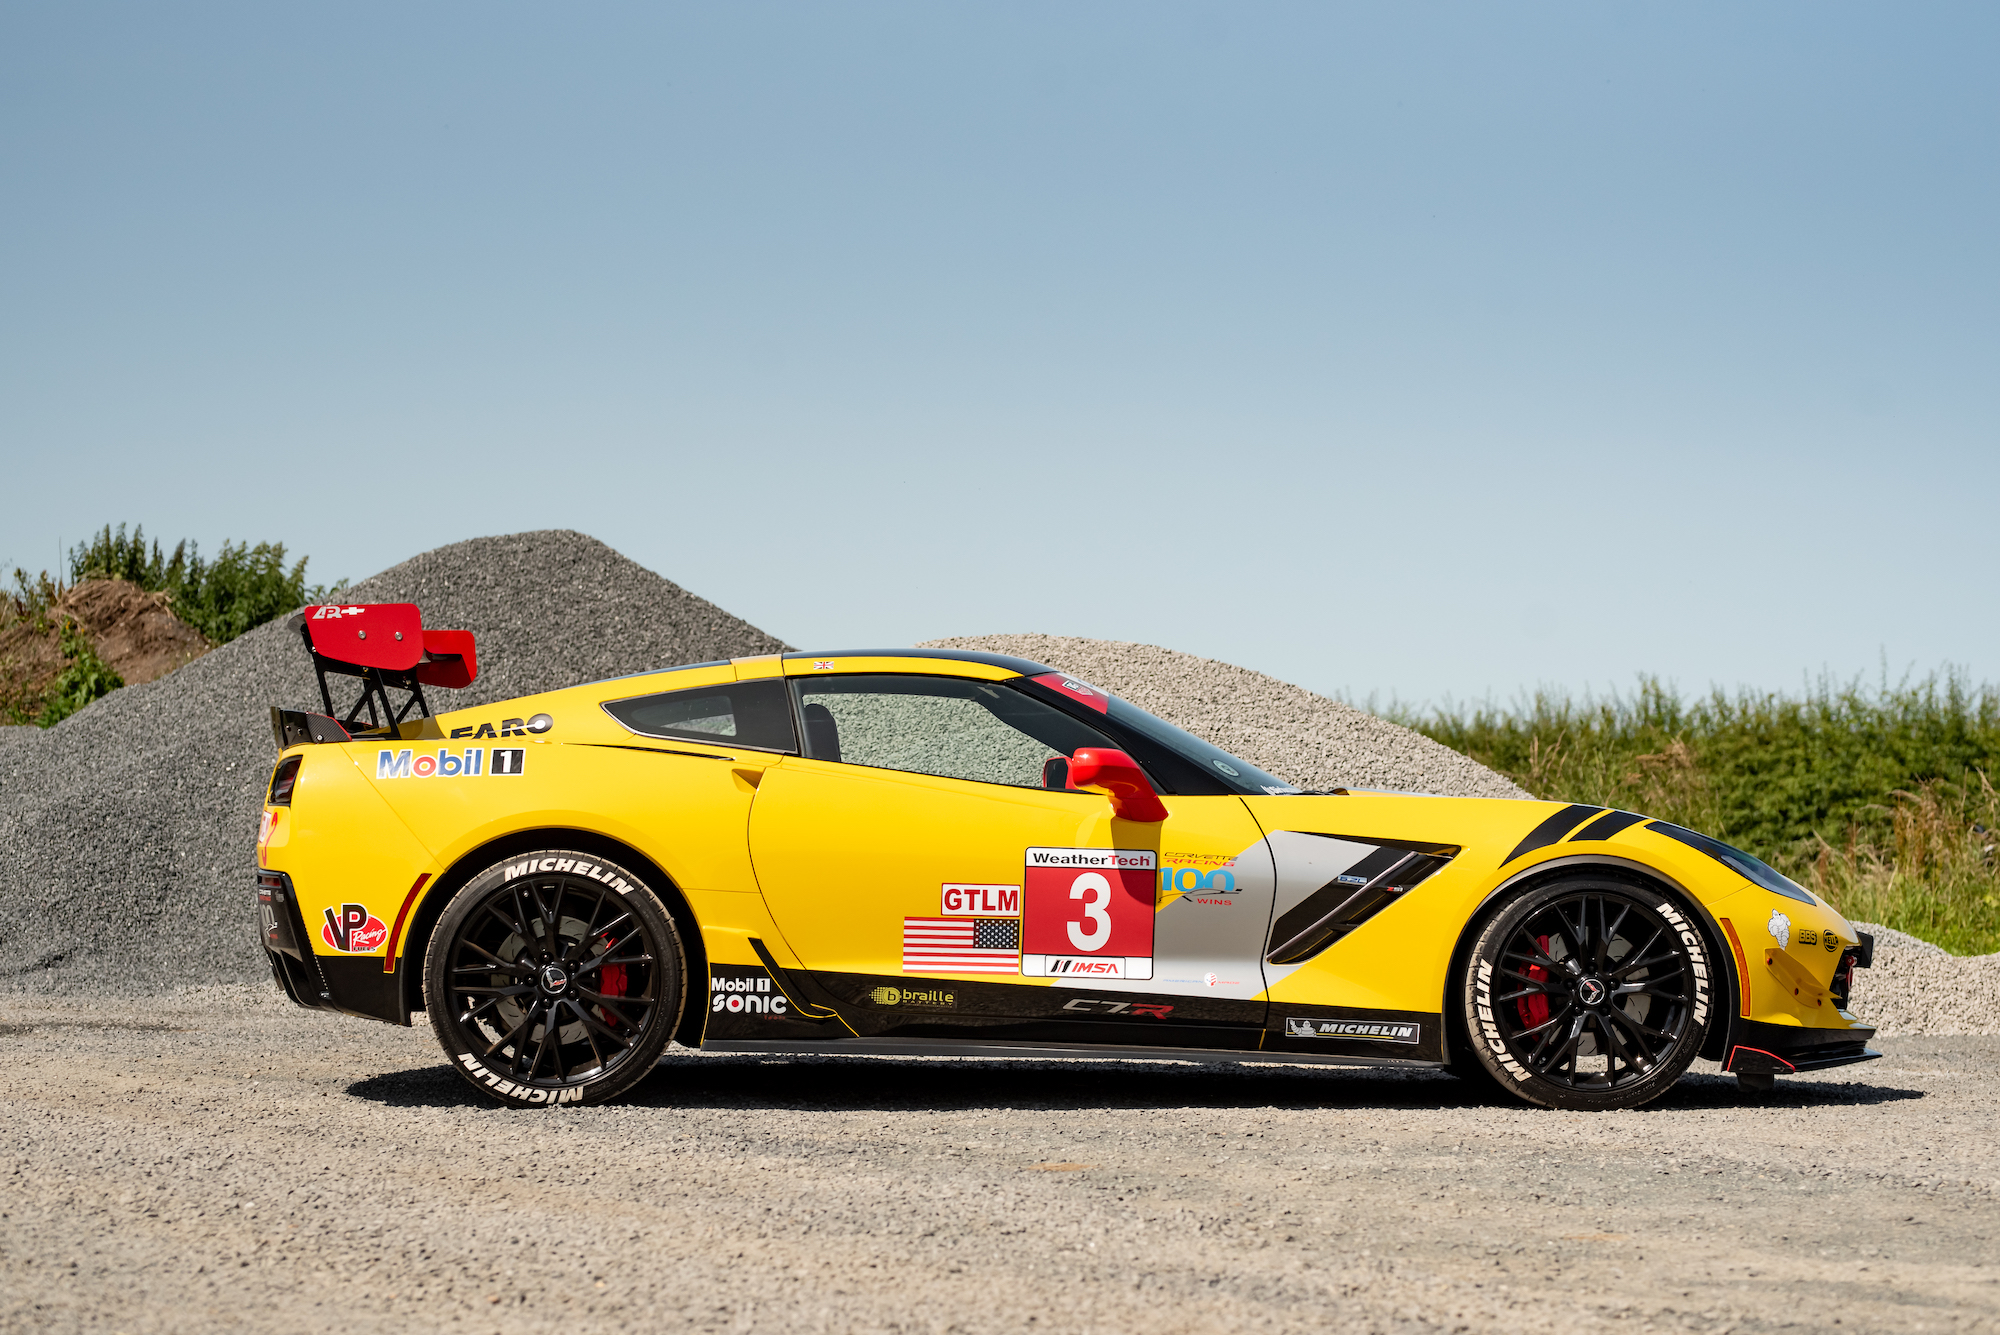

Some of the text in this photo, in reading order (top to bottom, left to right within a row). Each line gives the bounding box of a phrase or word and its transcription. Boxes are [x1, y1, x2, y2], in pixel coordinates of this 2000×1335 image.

[450, 713, 553, 739] FARO
[377, 748, 484, 778] Mobil
[1033, 853, 1150, 866] WeatherTech
[1163, 857, 1236, 867] RACING
[504, 857, 635, 896] MICHELIN
[1159, 867, 1235, 892] 100
[944, 888, 1018, 912] GTLM
[1066, 871, 1112, 952] 3
[1197, 898, 1232, 906] WINS
[323, 903, 368, 952] VP
[352, 927, 387, 946] Racing
[1799, 929, 1817, 945] BBS
[1072, 962, 1118, 974] IMSA
[1656, 902, 1711, 1026] MICHELIN
[711, 977, 754, 992] Mobil
[902, 988, 954, 1003] braille
[1319, 1023, 1413, 1037] MICHELIN
[1476, 958, 1533, 1083] MICHELIN
[458, 1053, 584, 1104] MICHELIN
